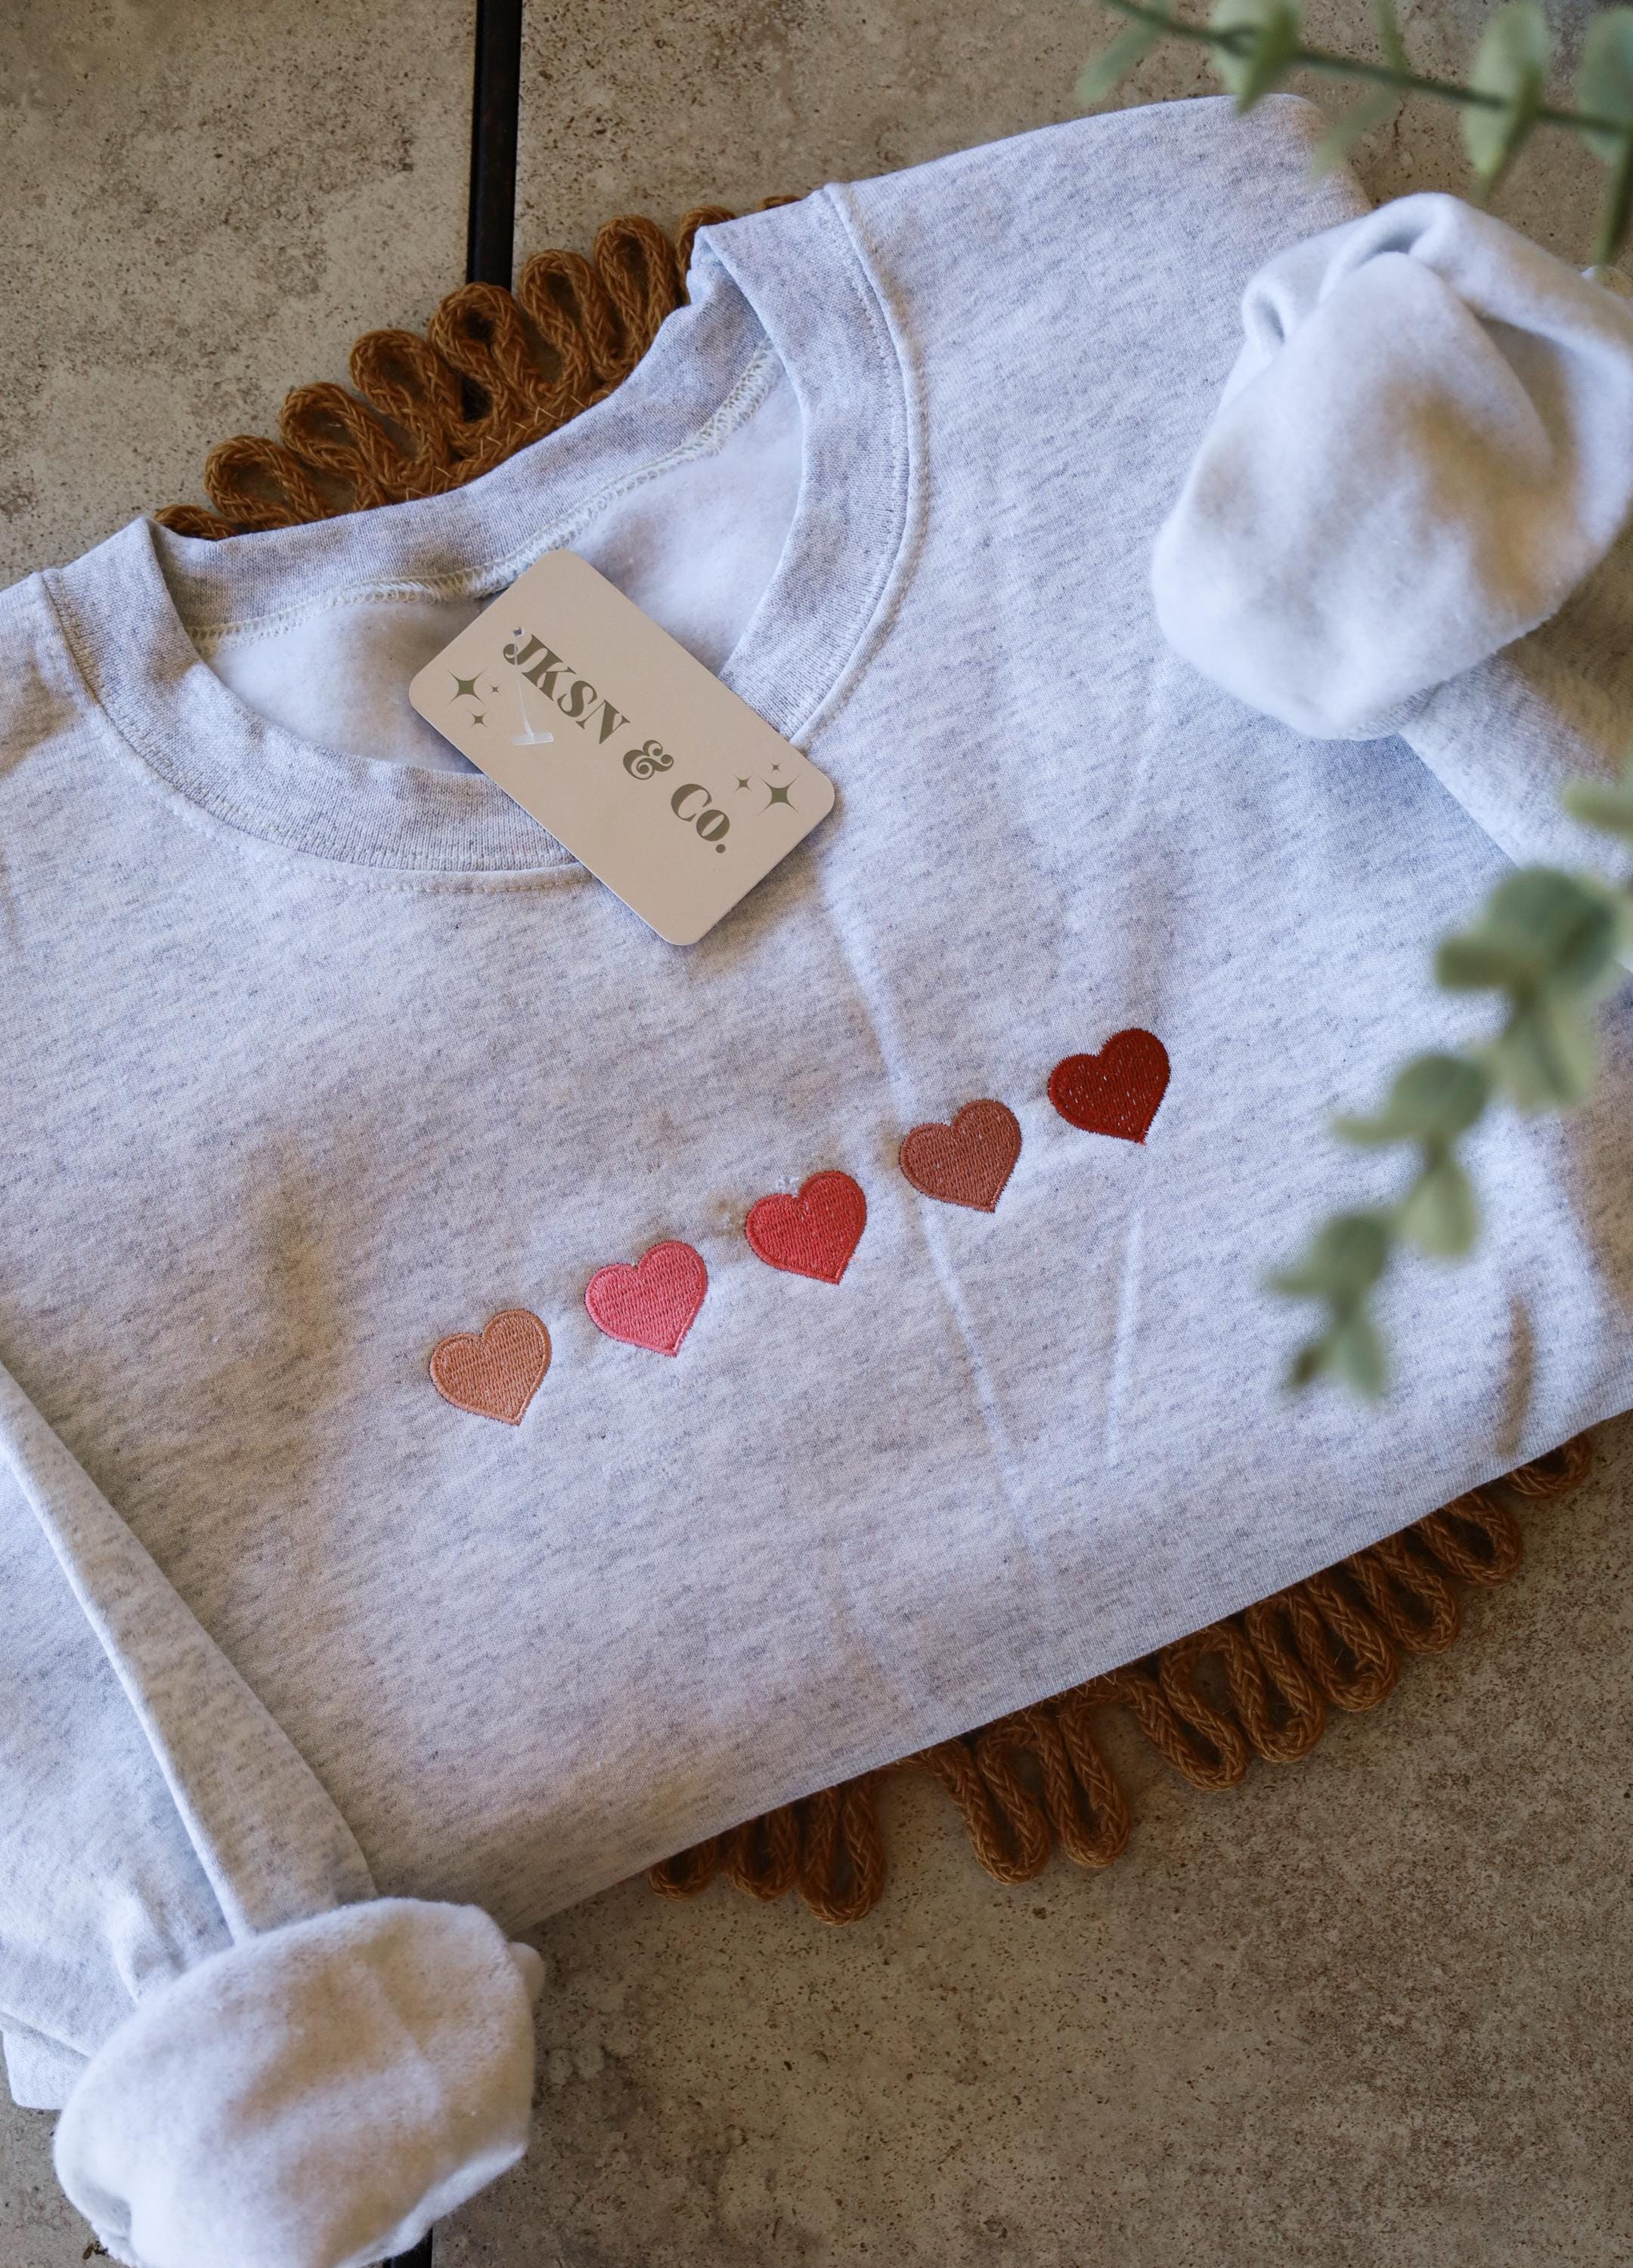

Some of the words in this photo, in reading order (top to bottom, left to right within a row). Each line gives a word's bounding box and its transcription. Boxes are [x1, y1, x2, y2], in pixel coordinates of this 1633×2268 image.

[503, 634, 631, 745] JKSN
[622, 739, 674, 780] &
[671, 783, 730, 854] CO.
